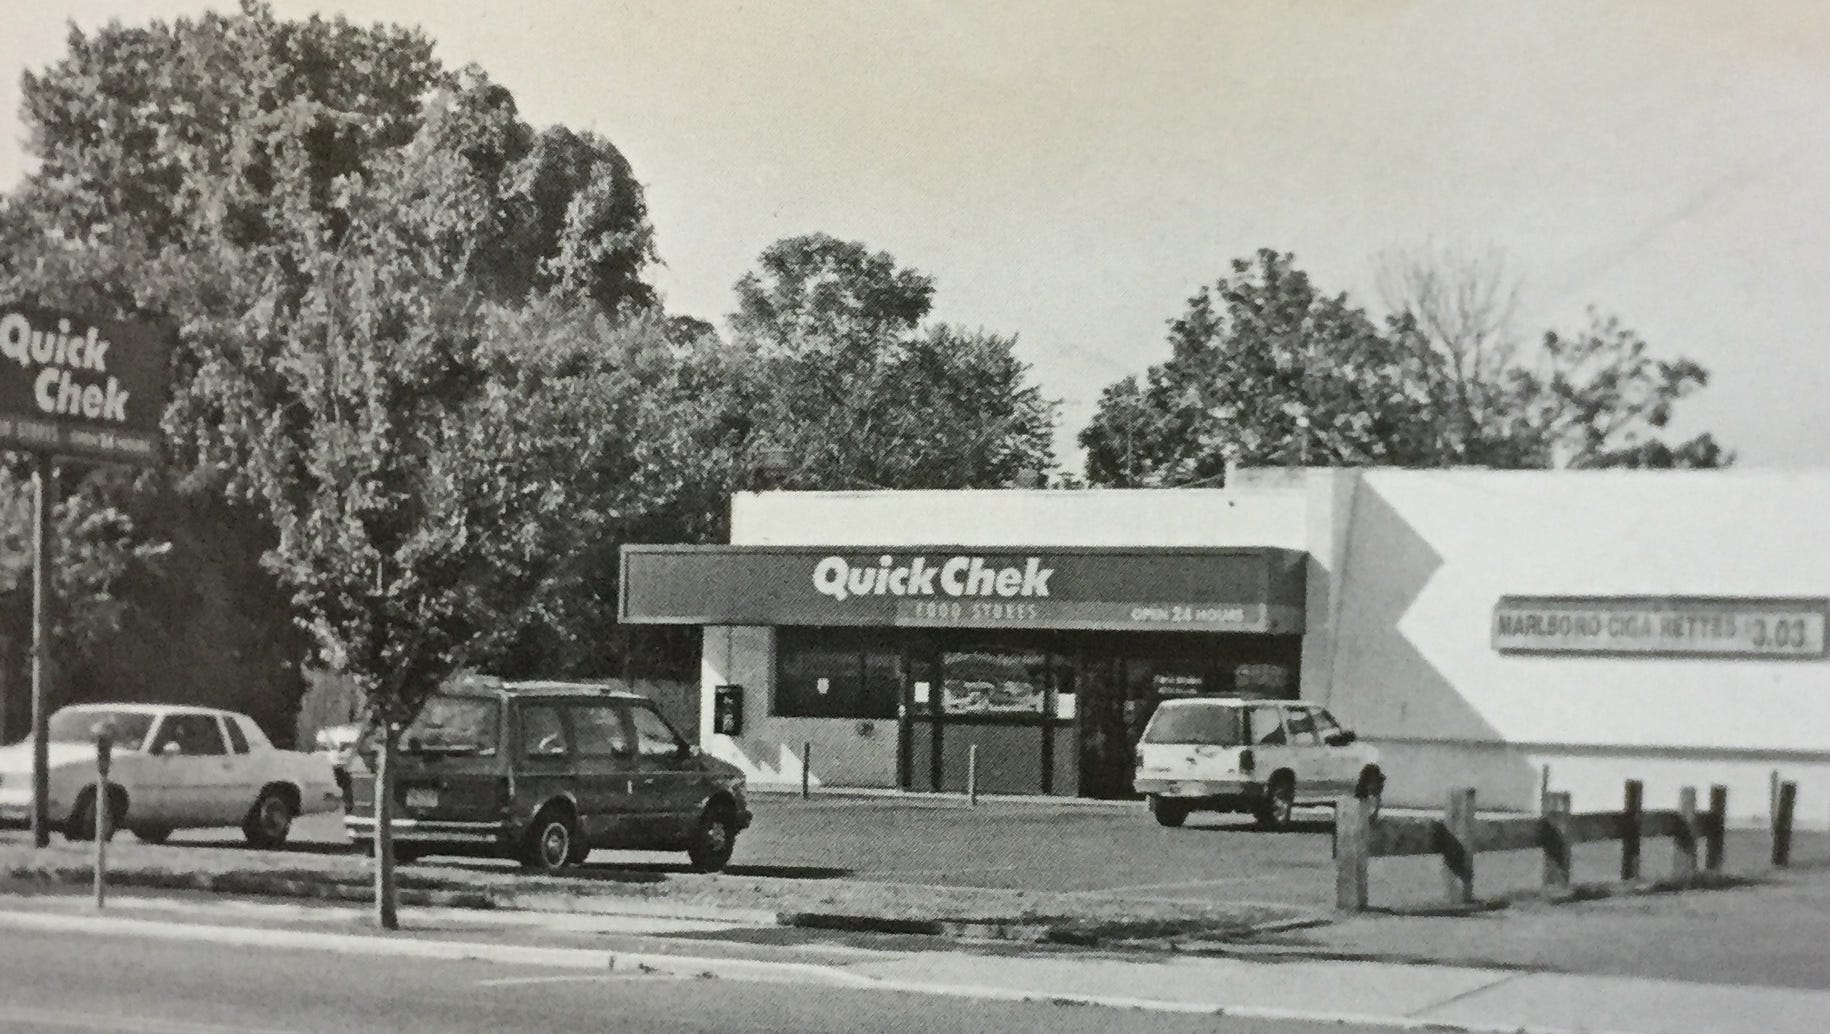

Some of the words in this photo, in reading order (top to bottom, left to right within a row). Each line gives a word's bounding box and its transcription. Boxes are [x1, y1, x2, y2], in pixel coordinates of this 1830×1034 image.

[0, 313, 111, 372] Quick
[34, 367, 130, 422] Chek
[812, 555, 939, 602] Quick
[940, 556, 1054, 597] Chek
[916, 601, 961, 619] FOOD
[973, 603, 1037, 620] STORES
